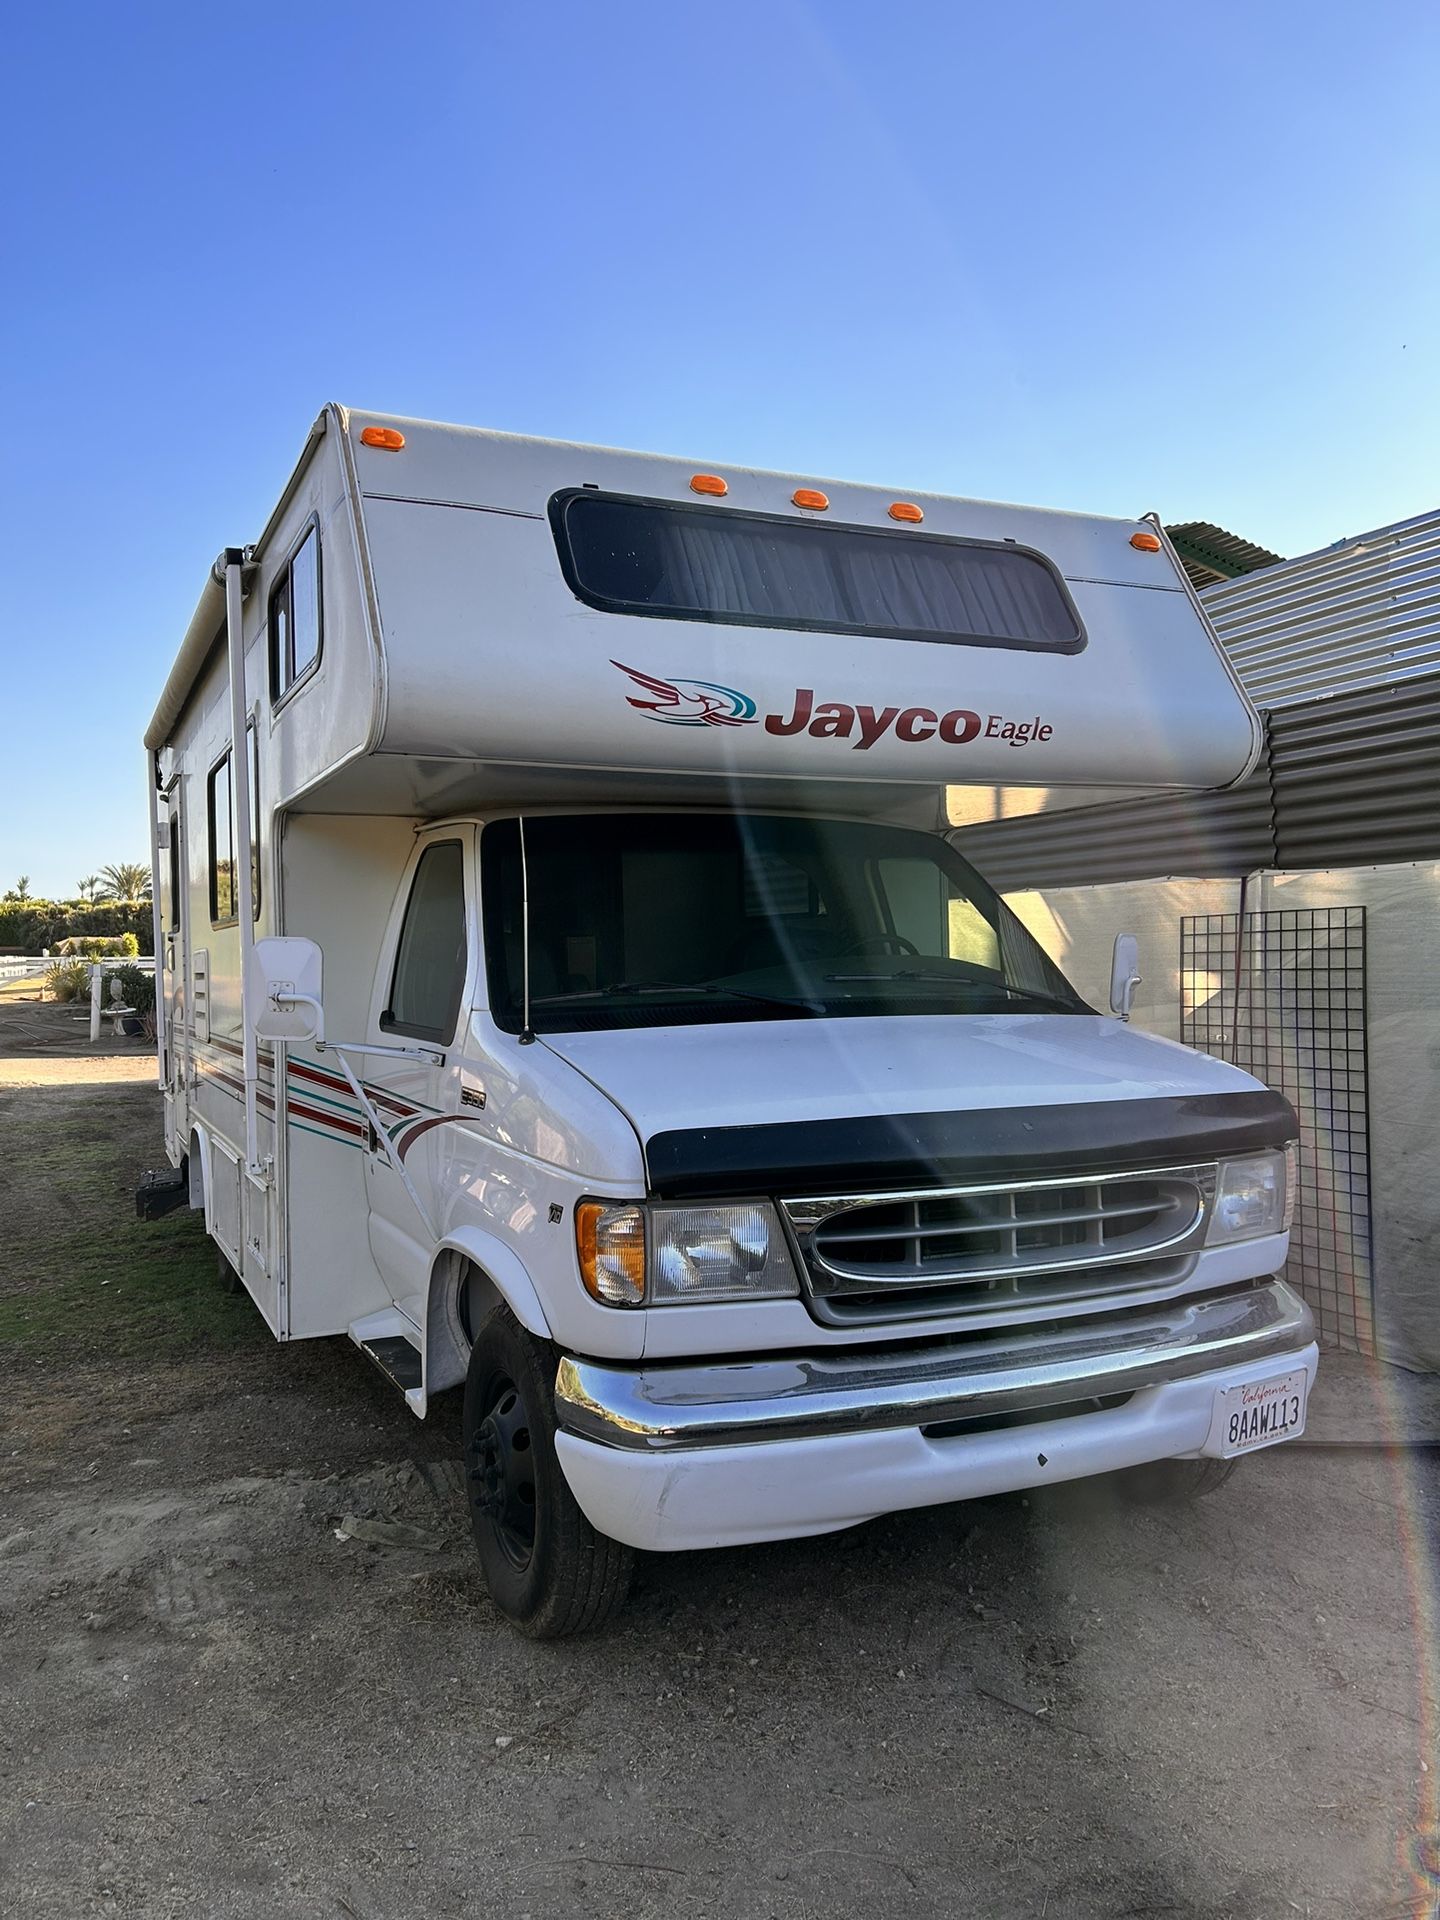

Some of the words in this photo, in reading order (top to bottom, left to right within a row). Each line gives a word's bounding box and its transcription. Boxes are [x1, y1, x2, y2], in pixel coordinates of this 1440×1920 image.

[764, 688, 982, 750] Jayco
[984, 714, 1054, 747] Eagle
[1242, 1384, 1290, 1405] California
[1229, 1396, 1299, 1443] 8AAW113
